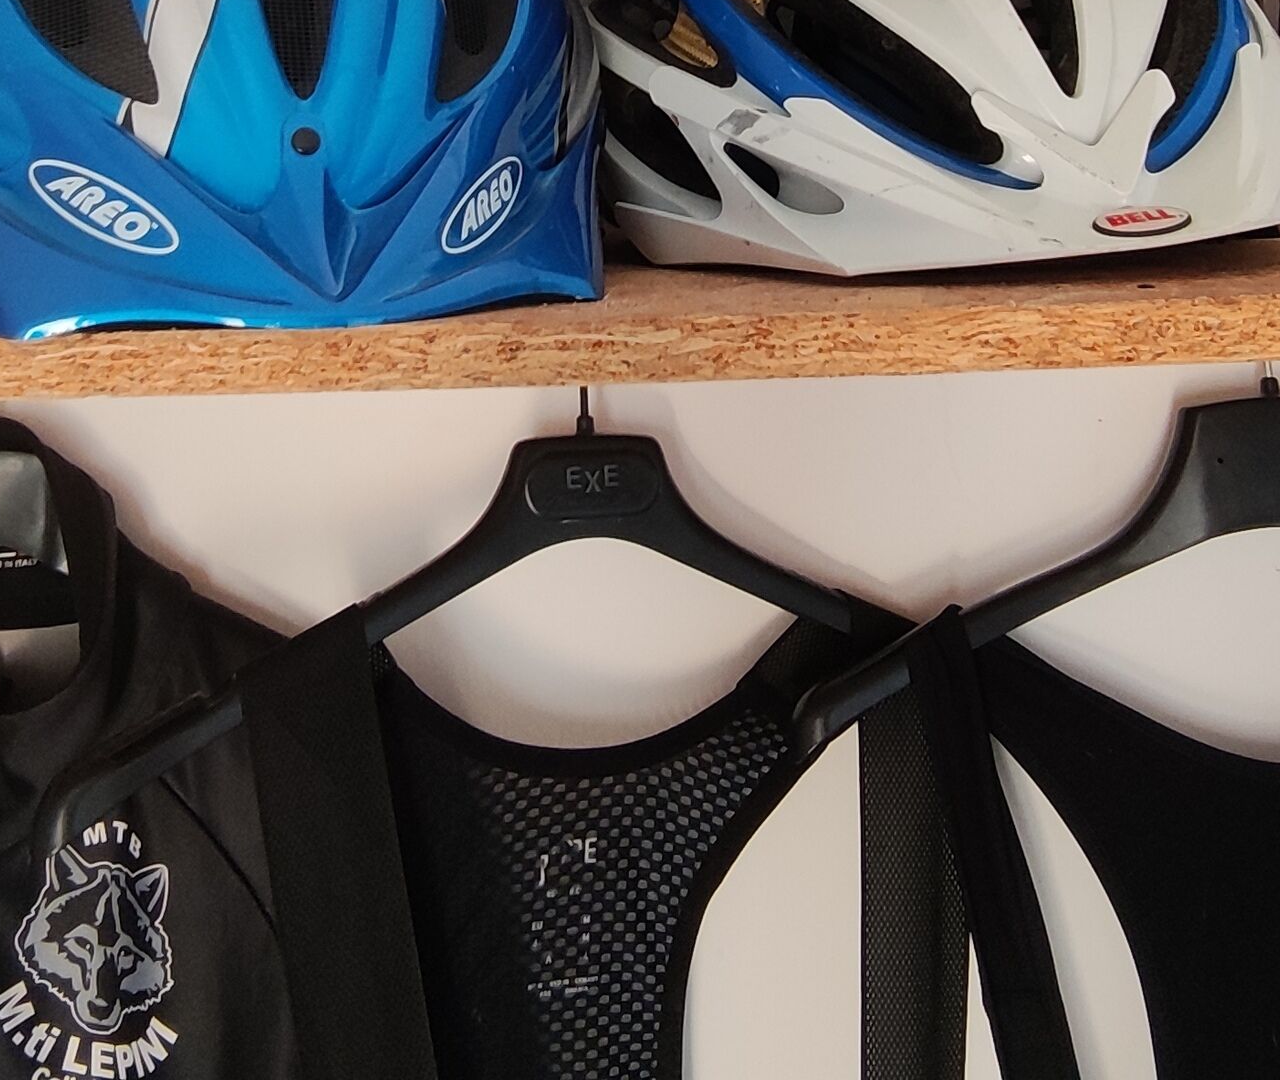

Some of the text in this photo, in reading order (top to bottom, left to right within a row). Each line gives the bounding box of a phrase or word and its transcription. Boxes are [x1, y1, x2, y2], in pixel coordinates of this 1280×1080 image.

[44, 175, 153, 242] AREO
[460, 168, 513, 242] AREO
[1104, 208, 1177, 227] BELL
[566, 464, 620, 494] EXE
[82, 820, 142, 860] MTB
